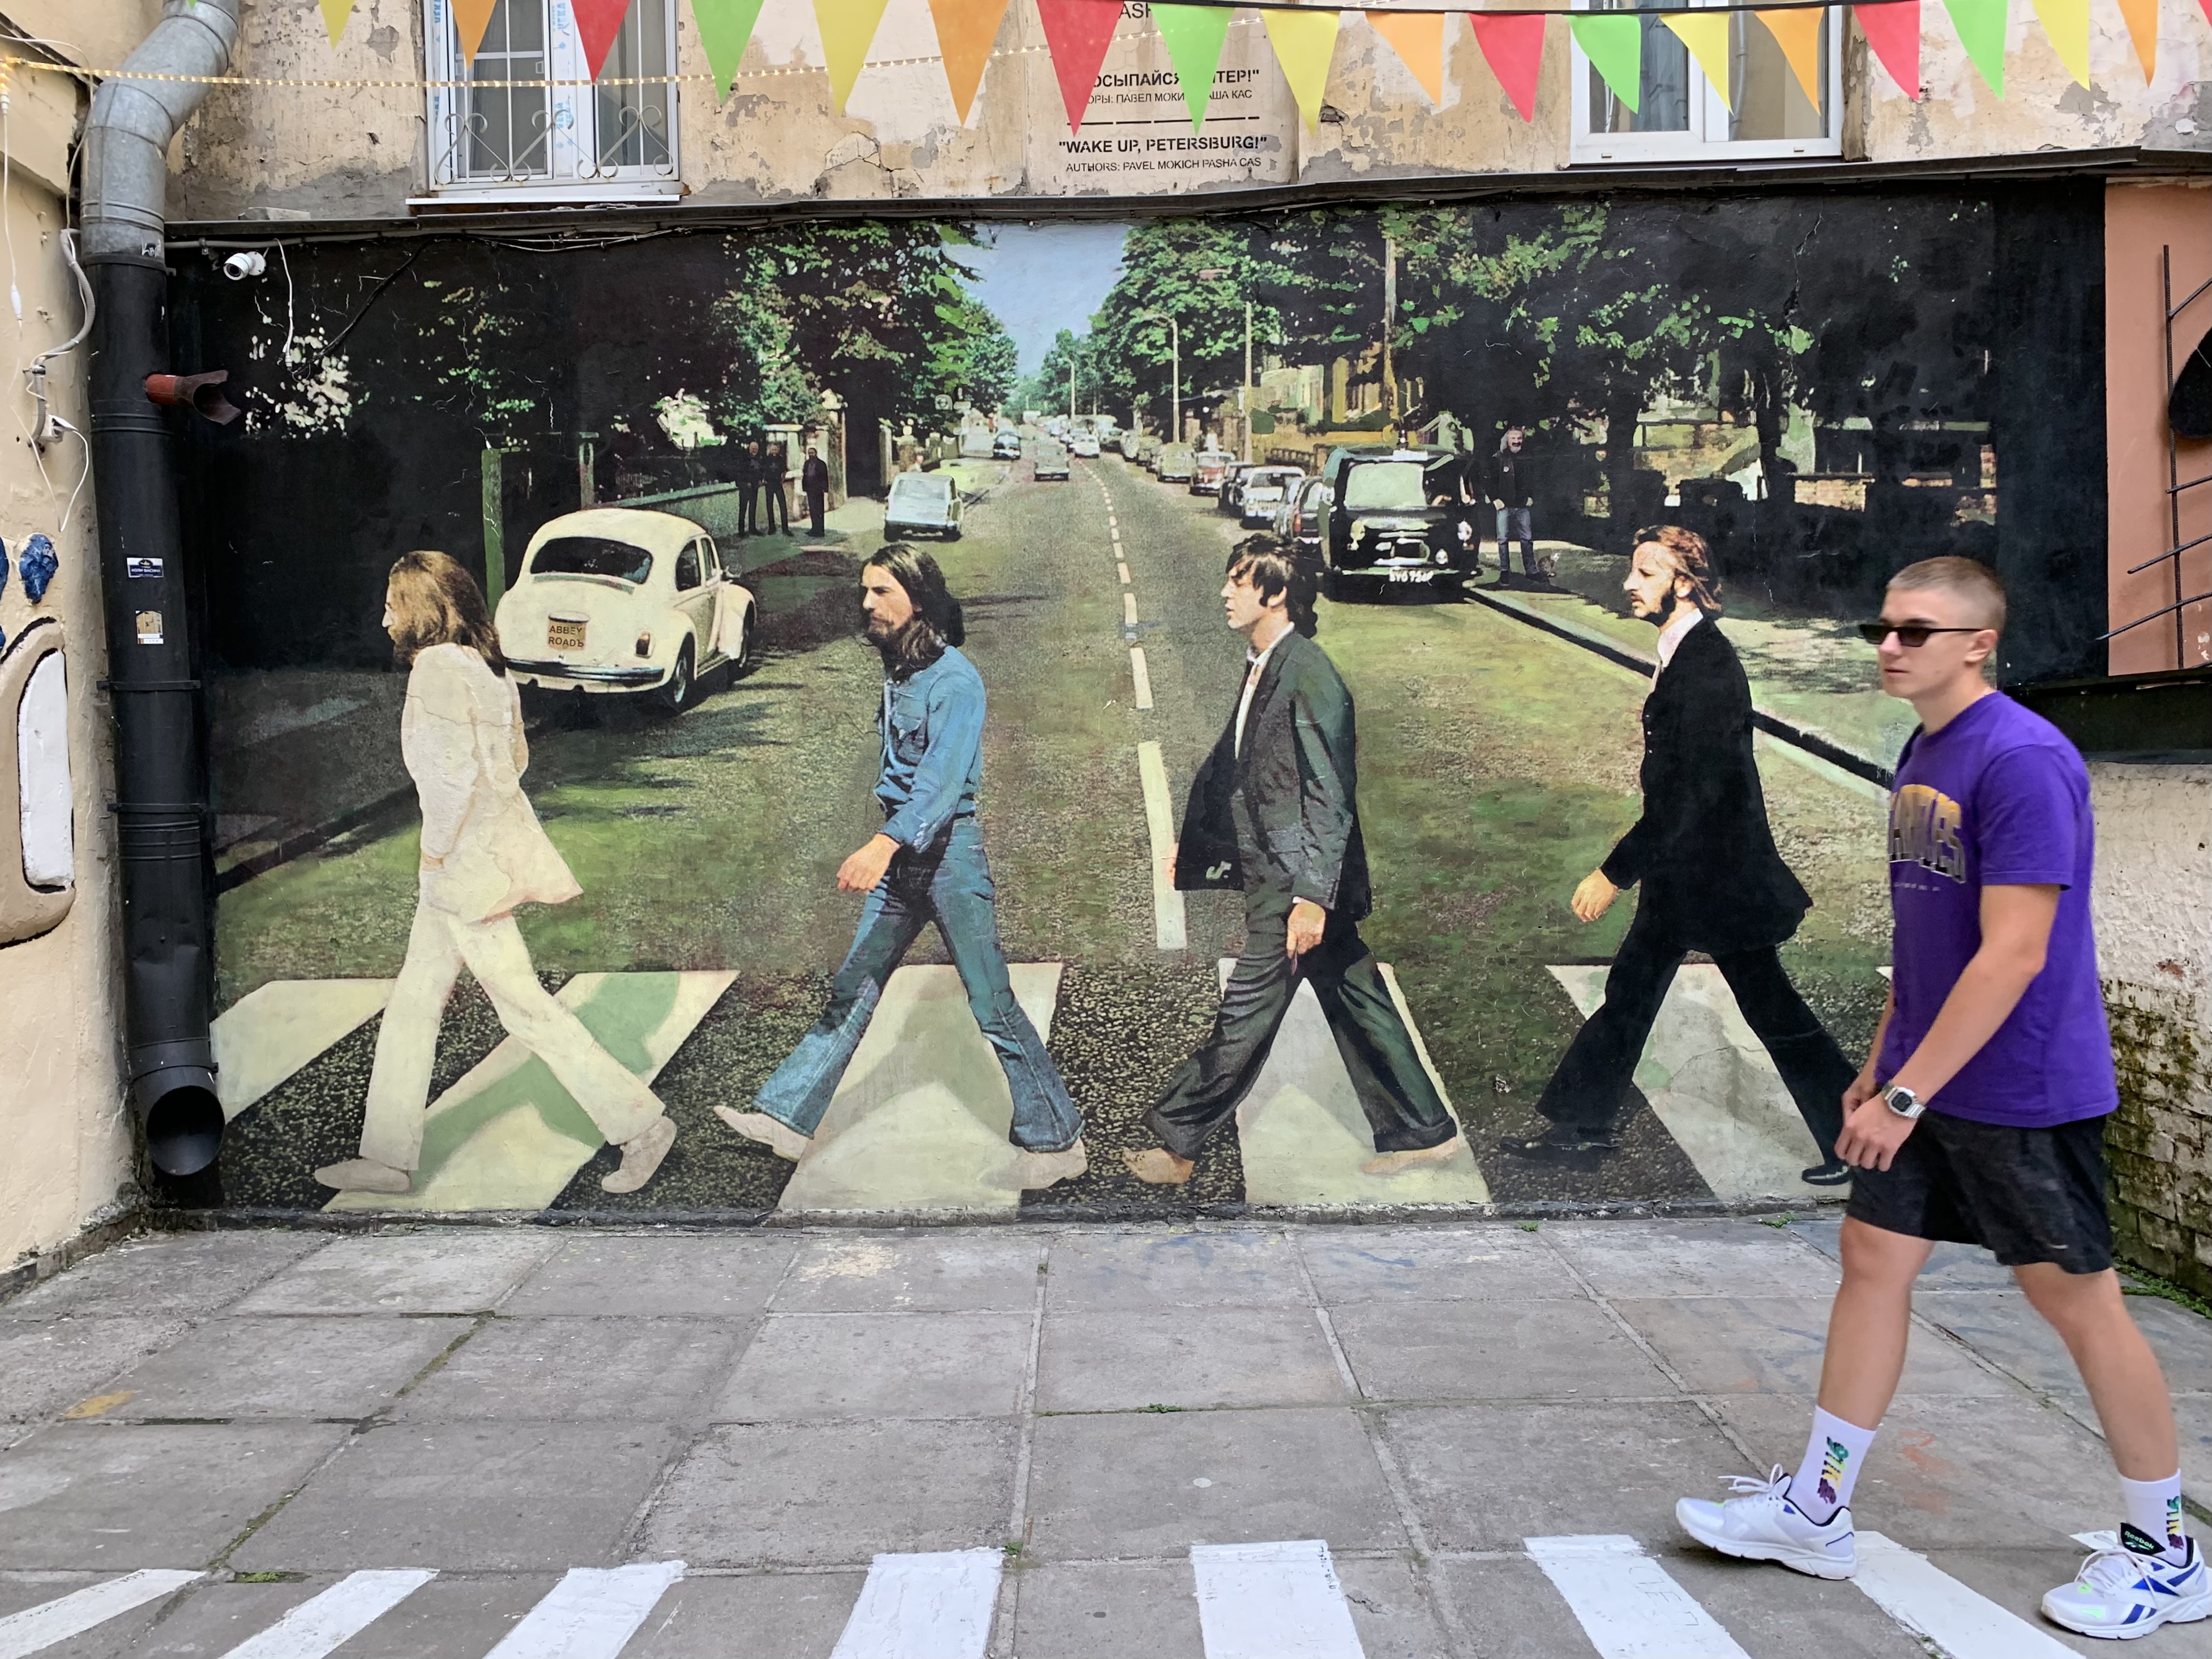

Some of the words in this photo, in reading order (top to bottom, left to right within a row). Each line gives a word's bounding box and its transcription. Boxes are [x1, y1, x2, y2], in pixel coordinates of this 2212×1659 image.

[1116, 93, 1152, 103] ПАВЕЛ
[1155, 92, 1184, 102] МОКИ
[1232, 89, 1252, 99] КАС
[1059, 140, 1113, 153] "WAKE
[1118, 139, 1141, 154] UP,
[1146, 136, 1267, 151] PETERSBURG!"
[1066, 162, 1120, 172] AUTHORS:
[1123, 161, 1156, 170] PAVEL
[1158, 159, 1199, 170] MOKICH
[1203, 158, 1237, 168] PASHA
[1239, 157, 1261, 167] CAS
[549, 625, 582, 635] ABBEY
[2124, 1531, 2154, 1549] Reebok
